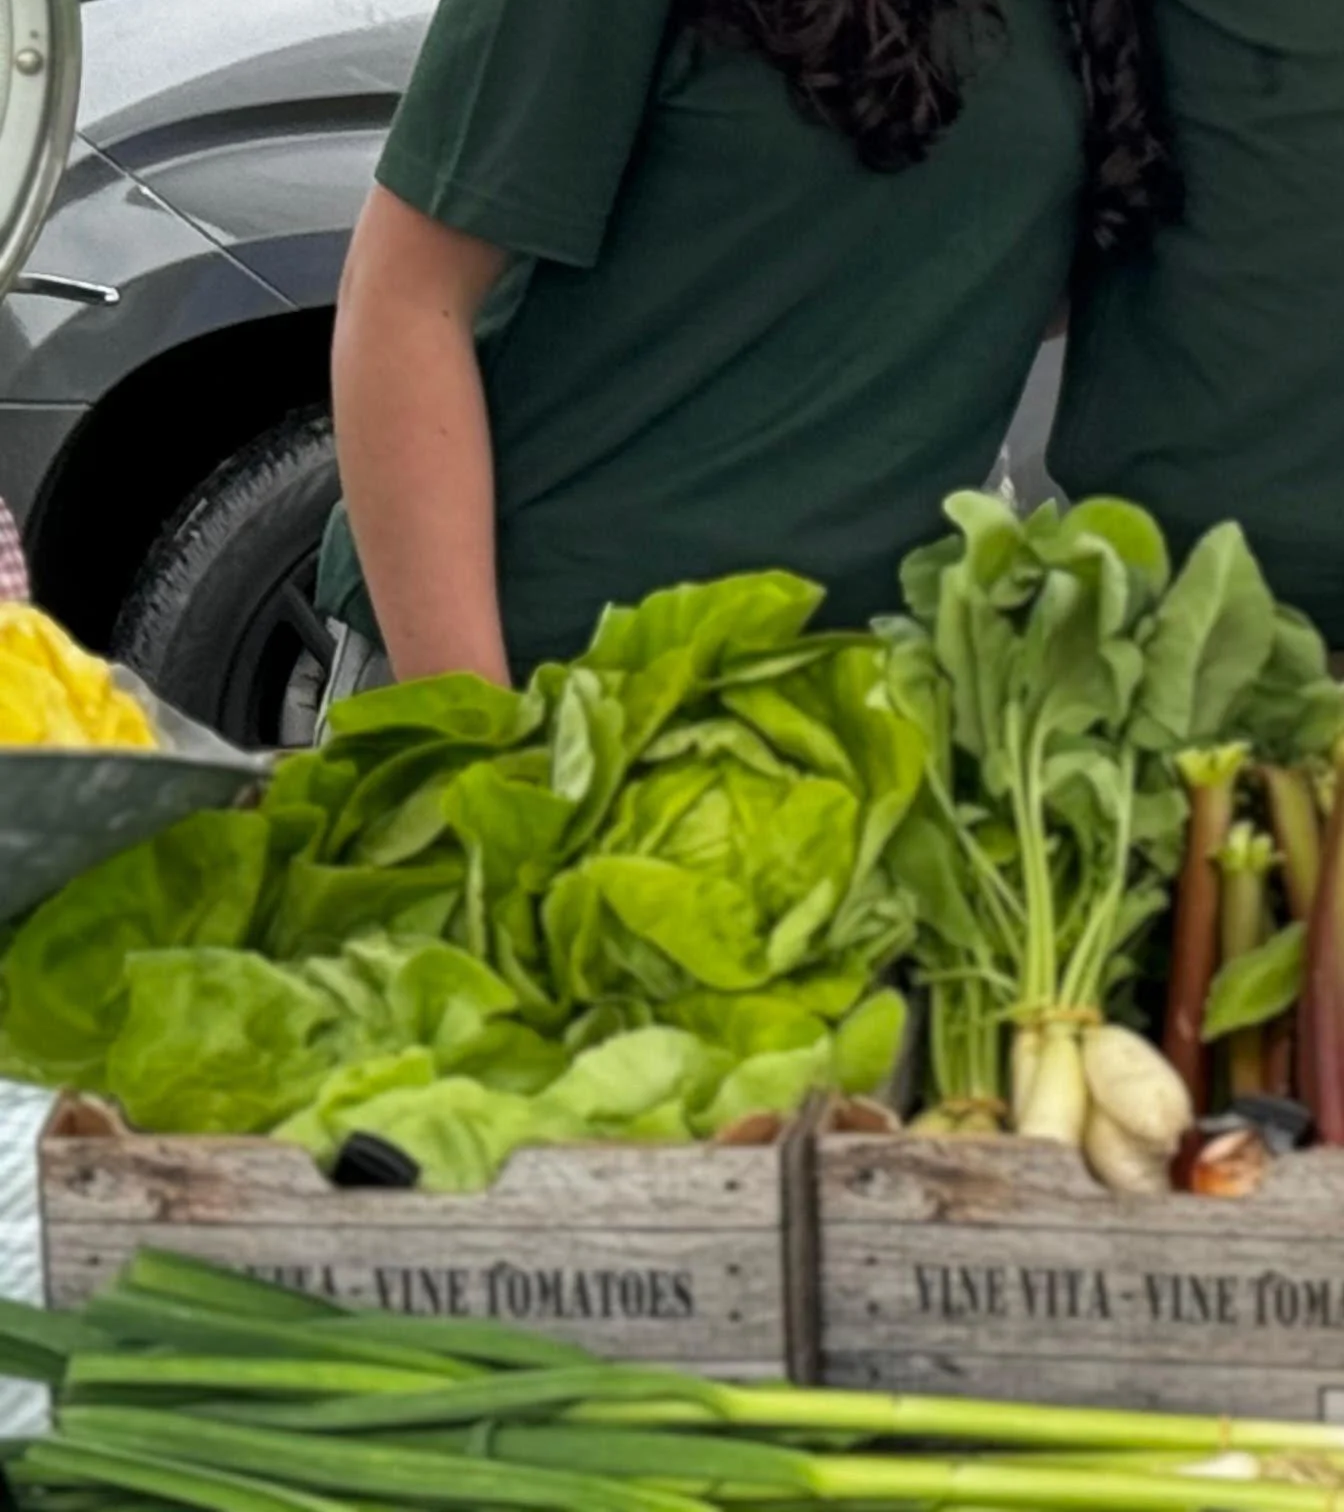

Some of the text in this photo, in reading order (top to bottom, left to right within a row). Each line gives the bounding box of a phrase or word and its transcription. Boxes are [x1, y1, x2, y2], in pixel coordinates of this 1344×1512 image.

[374, 1265, 469, 1317] VINE
[486, 1258, 695, 1319] TOMATOES
[914, 1264, 1005, 1318] VINE
[1017, 1265, 1111, 1319] VITA
[1144, 1271, 1238, 1325] VINE
